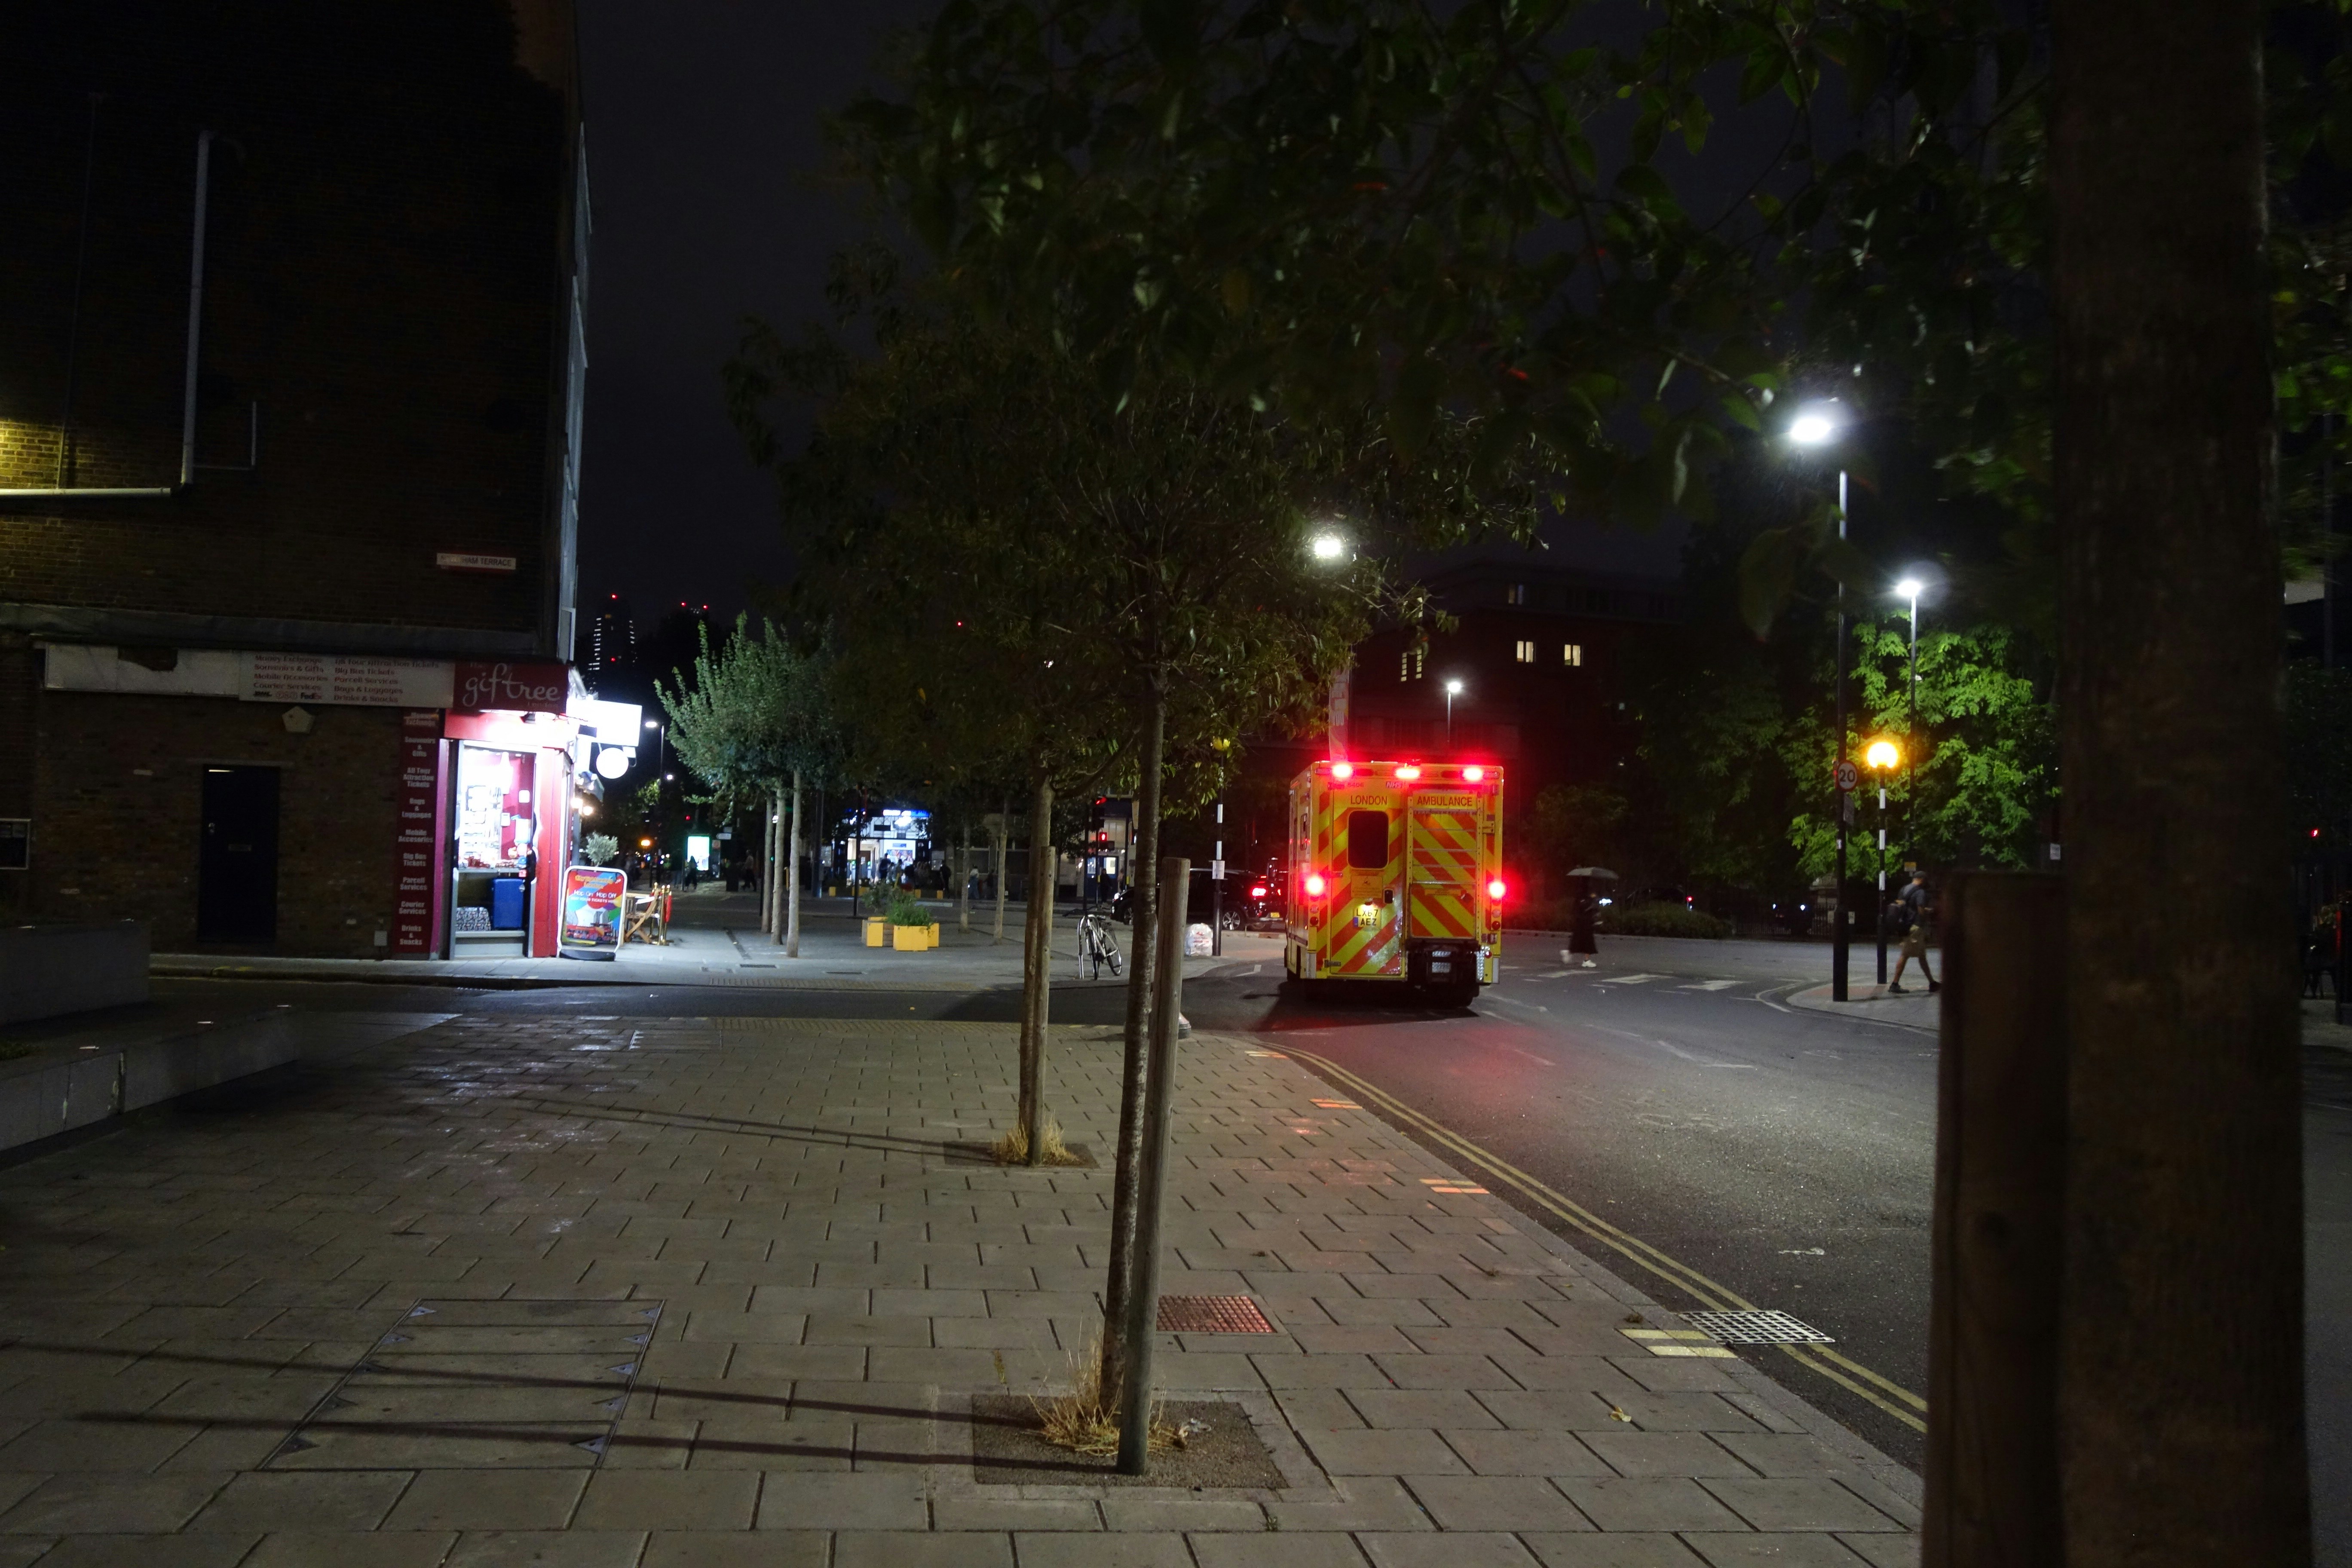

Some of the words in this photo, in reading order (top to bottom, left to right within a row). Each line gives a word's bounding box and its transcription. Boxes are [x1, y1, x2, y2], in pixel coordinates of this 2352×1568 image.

[480, 557, 512, 567] TERRACE
[1839, 769, 1855, 782] 20
[1351, 796, 1387, 805] LONDON
[1417, 796, 1473, 806] AMBULANCE
[1357, 908, 1378, 916] LX67
